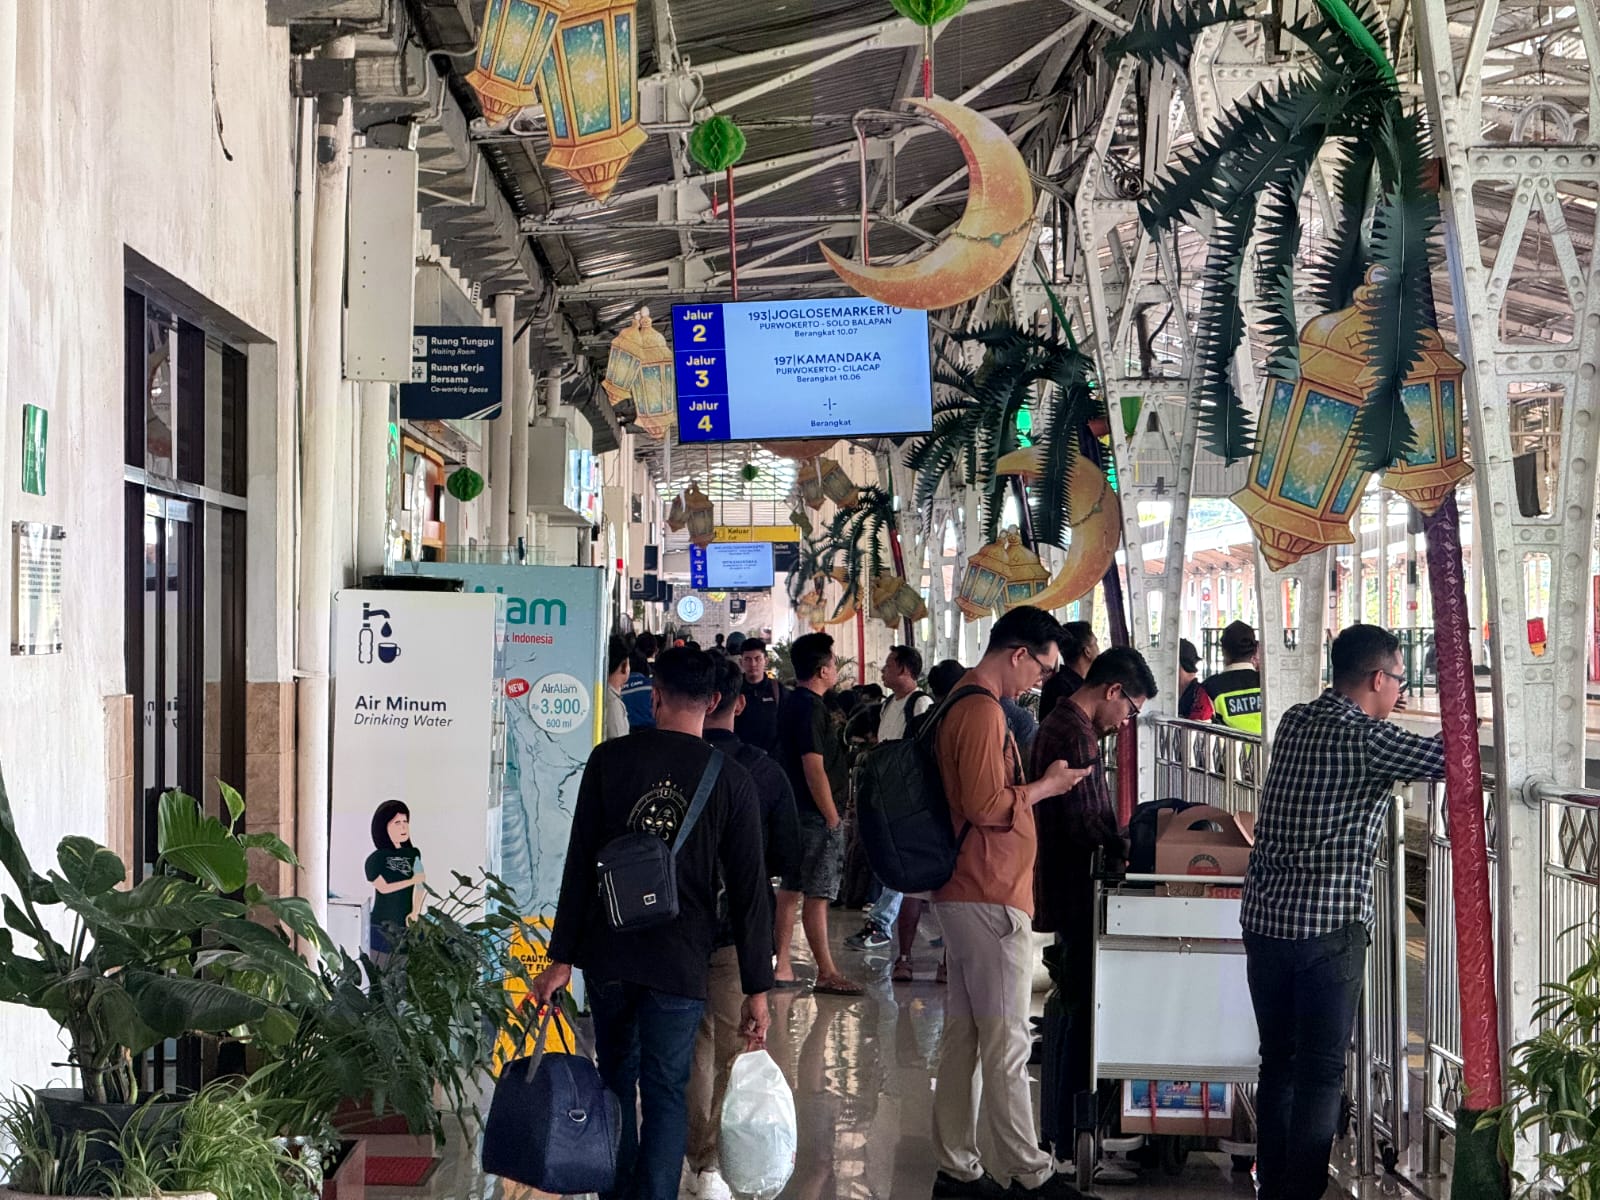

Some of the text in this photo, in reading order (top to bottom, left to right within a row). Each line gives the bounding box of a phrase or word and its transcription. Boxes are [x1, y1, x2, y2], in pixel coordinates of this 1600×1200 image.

[683, 310, 714, 321] Jalur
[760, 321, 820, 330] PURWOKERTO
[826, 320, 850, 328] SOLO
[852, 318, 892, 326] BALAPAN
[692, 324, 707, 342] 2
[794, 328, 858, 338] Berangkat 10.07
[431, 336, 495, 347] Ruang Tunggu
[431, 348, 456, 356] Waiting
[686, 356, 716, 366] Jalur
[774, 352, 881, 366] 197|KAMANDAKA
[431, 363, 485, 374] Ruang Kerja
[776, 366, 836, 375] PURWOKERTO
[843, 364, 880, 372] CILACAP
[431, 375, 469, 383] Bersama
[695, 370, 709, 388] 3
[797, 375, 837, 383] Berangkat
[431, 386, 468, 394] Co-working
[689, 401, 719, 411] Jalur
[697, 415, 713, 432] 4
[811, 419, 851, 427] Berangkat
[512, 632, 554, 645] Indonesia
[508, 682, 525, 694] NEW
[541, 683, 578, 694] AirAlam
[354, 695, 447, 711] Air Minum
[354, 713, 454, 728] Drinking Water
[546, 719, 572, 728] 600 ml
[520, 954, 553, 963] CAUTIO
